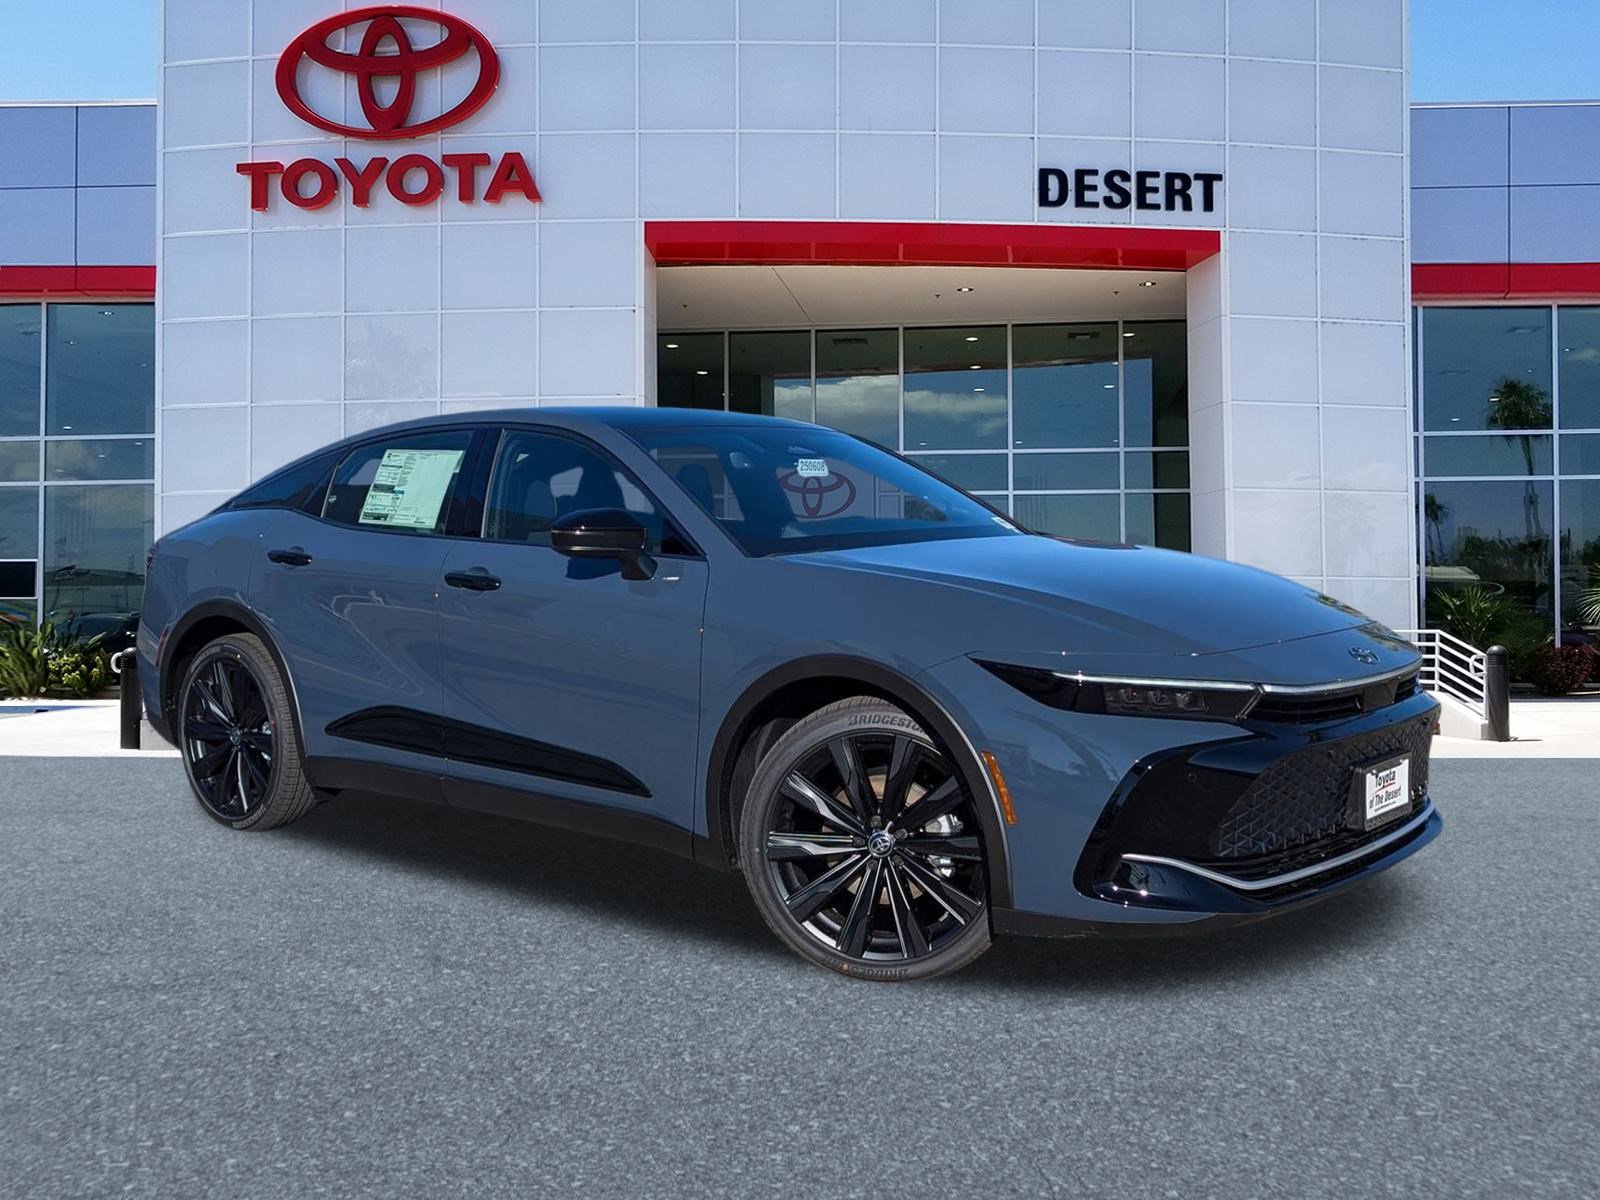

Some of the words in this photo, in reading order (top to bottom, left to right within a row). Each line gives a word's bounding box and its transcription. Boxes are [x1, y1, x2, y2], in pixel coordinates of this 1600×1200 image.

[236, 152, 542, 211] TOYOTA
[1038, 168, 1223, 212] DESERT
[800, 461, 825, 472] 250608
[1375, 769, 1396, 788] Toyota
[1375, 794, 1384, 806] The
[1385, 785, 1401, 802] Desert
